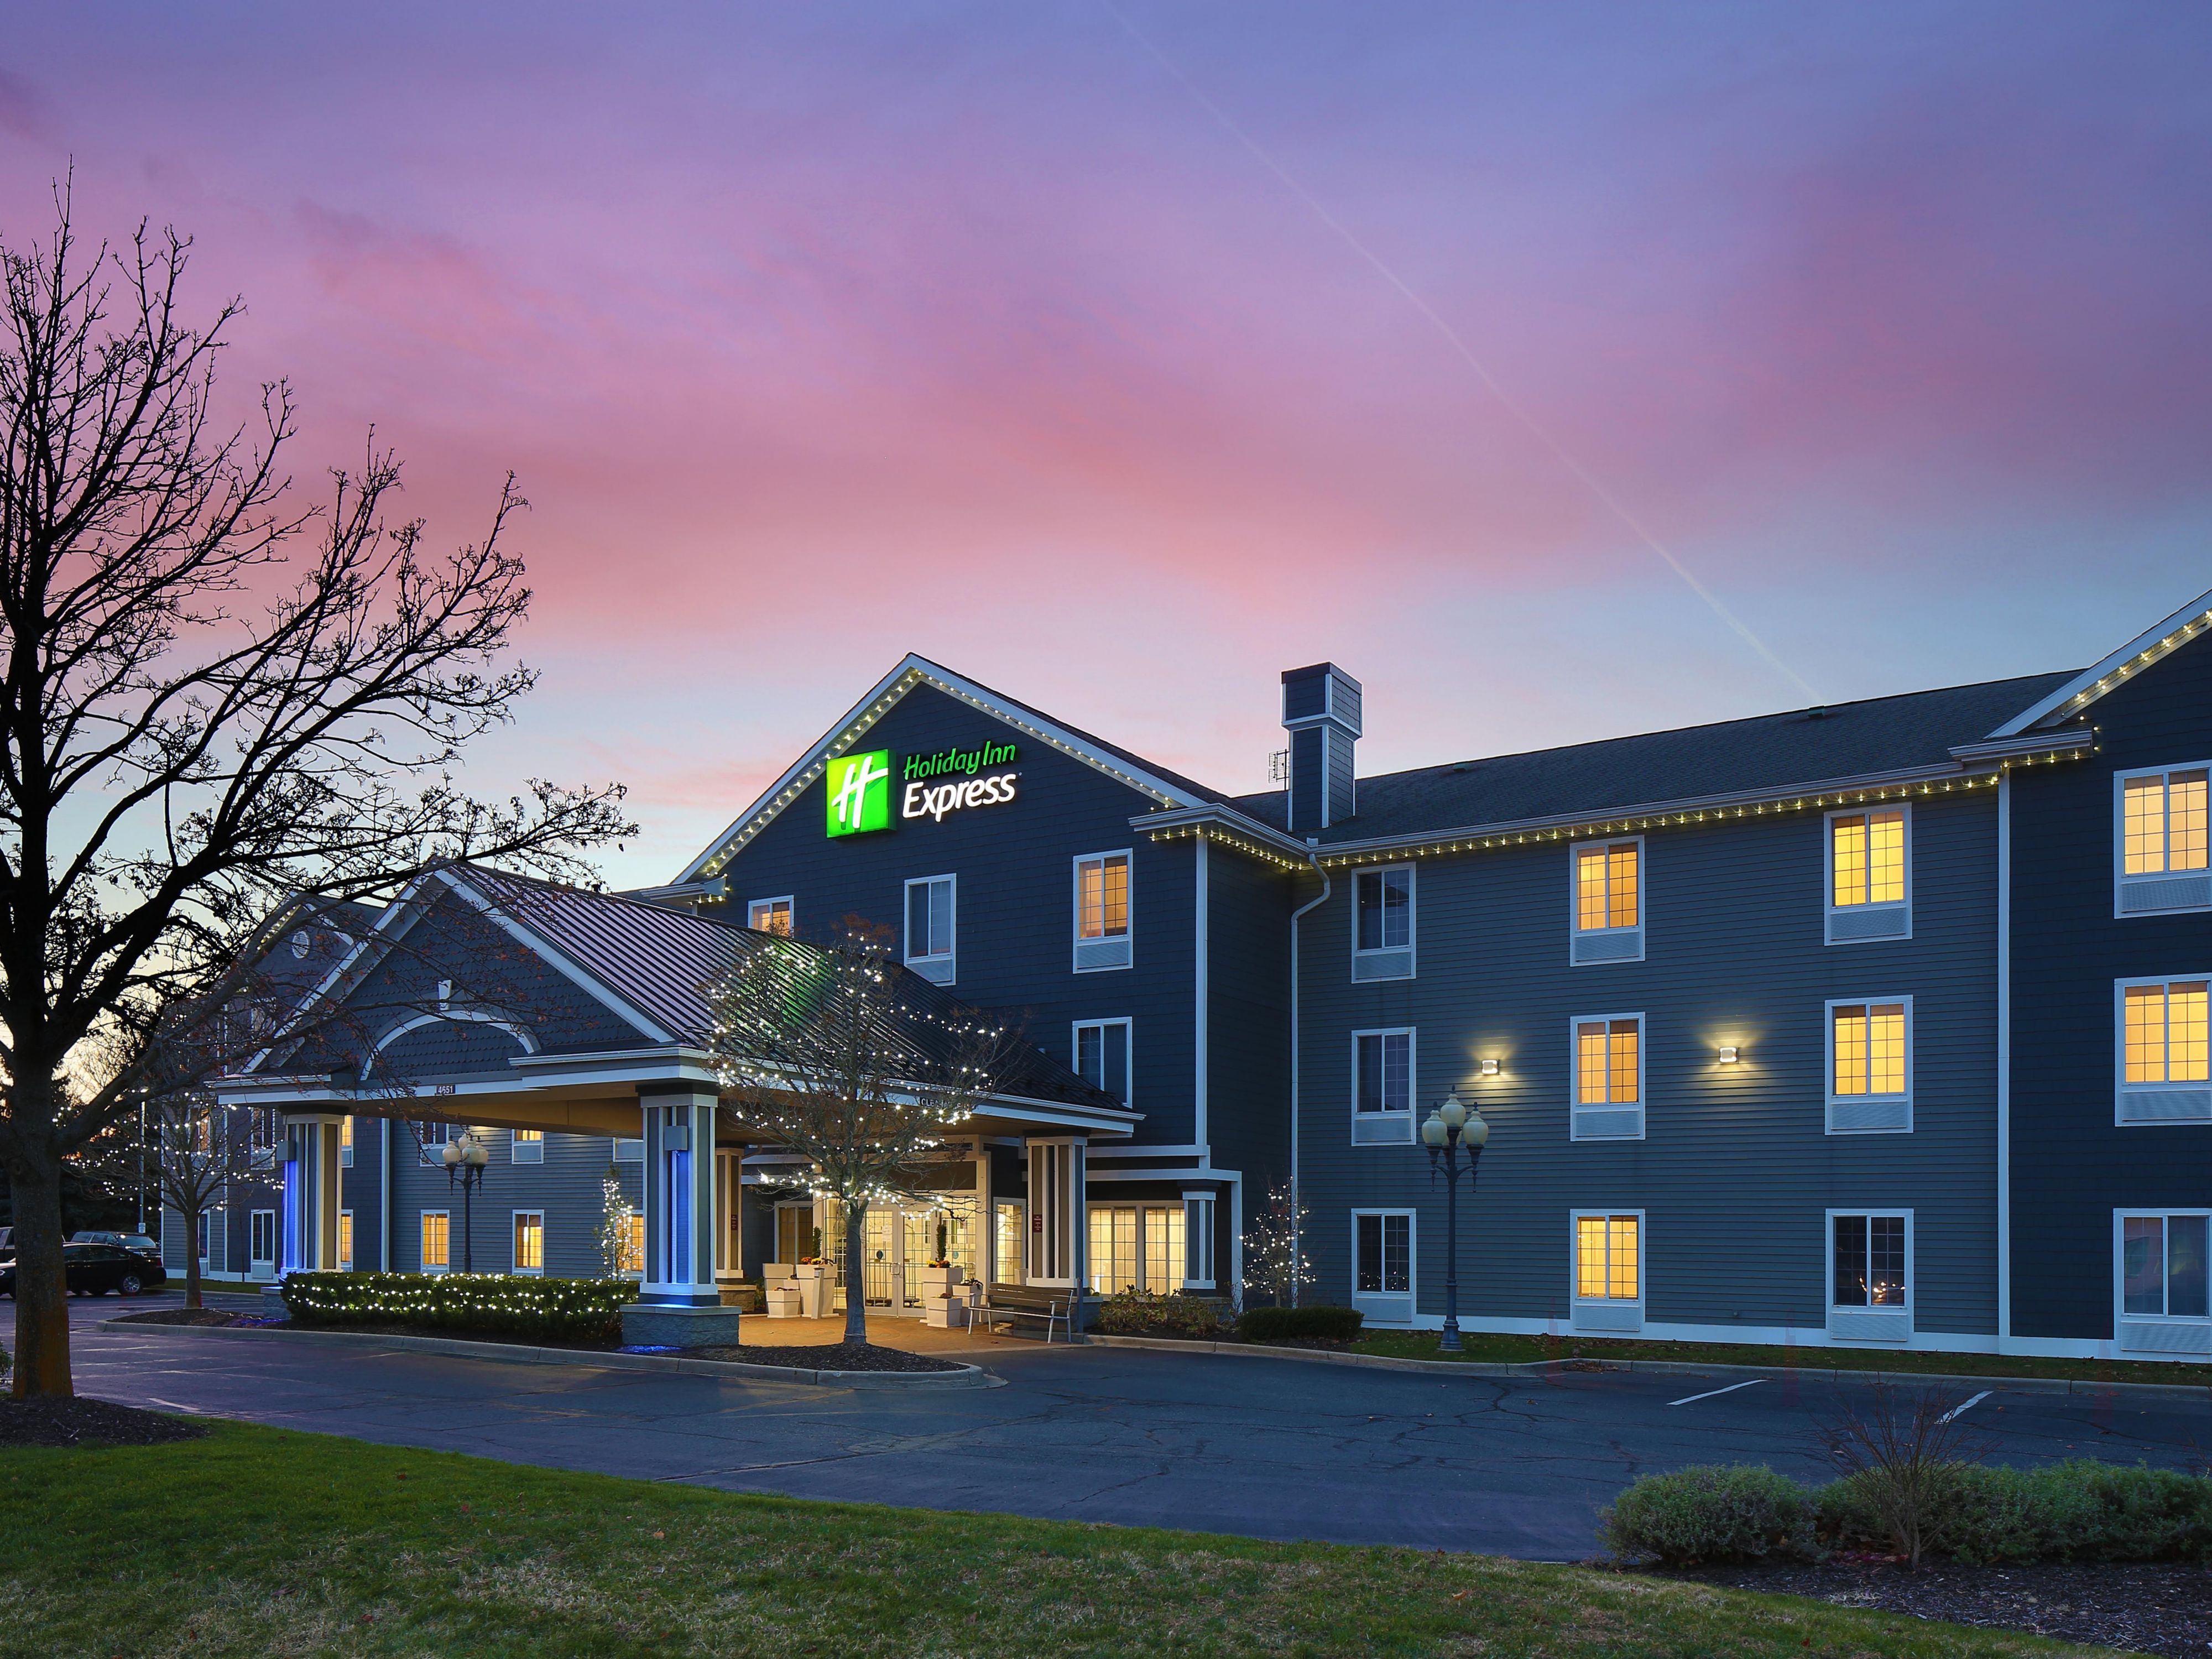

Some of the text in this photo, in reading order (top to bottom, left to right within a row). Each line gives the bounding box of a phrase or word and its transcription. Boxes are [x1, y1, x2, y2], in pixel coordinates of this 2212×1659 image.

[904, 740, 1016, 780] Holiday Inn
[902, 773, 1016, 823] Express
